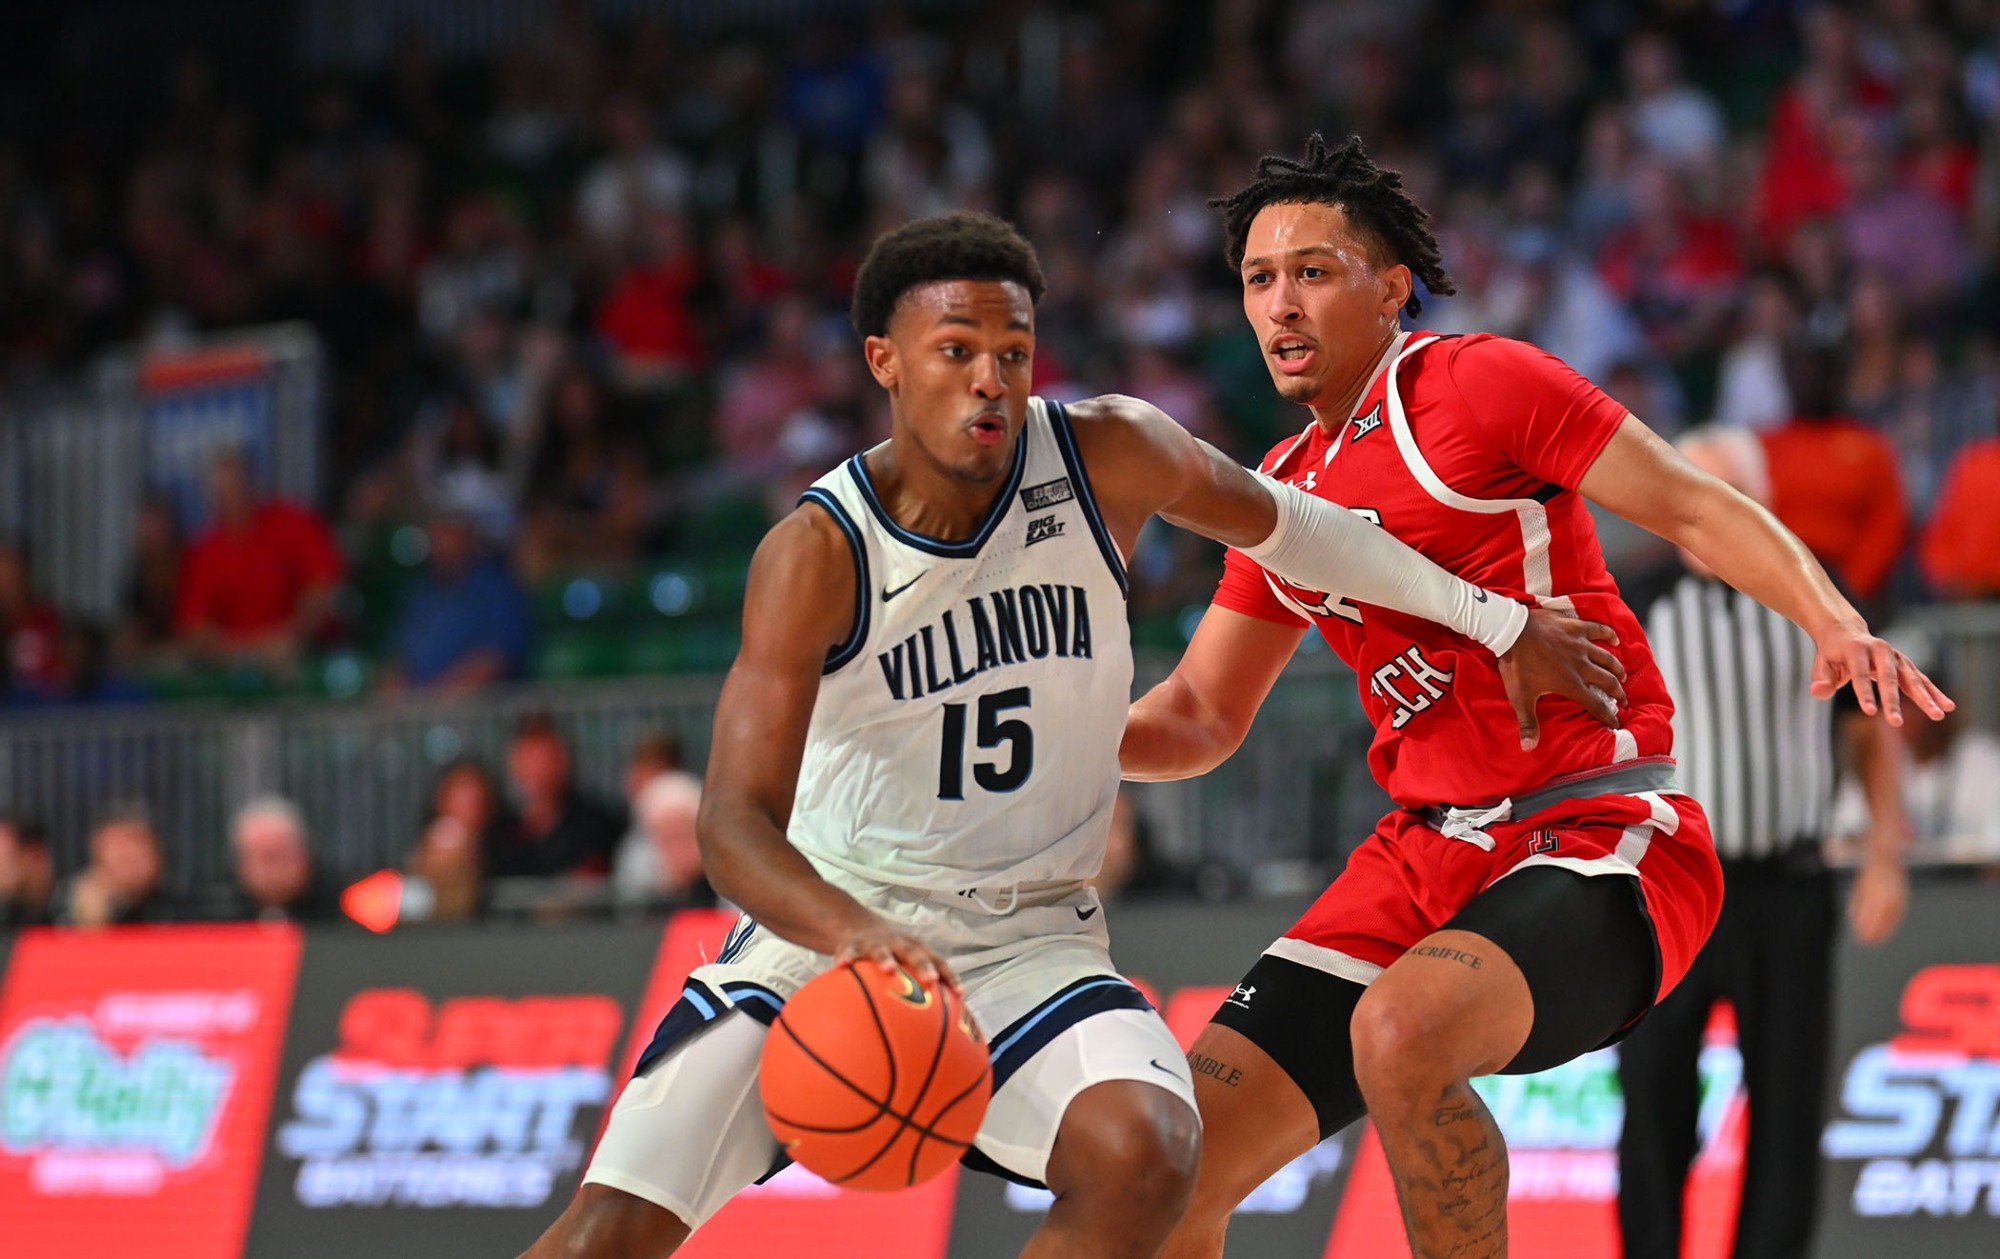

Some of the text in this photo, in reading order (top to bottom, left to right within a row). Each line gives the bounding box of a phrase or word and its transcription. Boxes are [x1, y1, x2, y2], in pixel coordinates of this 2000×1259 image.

[1025, 522, 1066, 542] EAST
[1028, 514, 1056, 532] BIG
[877, 584, 1093, 700] VILLANOVA
[937, 686, 1034, 801] 15
[1410, 946, 1484, 970] ACRIFICE
[1820, 1044, 2000, 1158] ST
